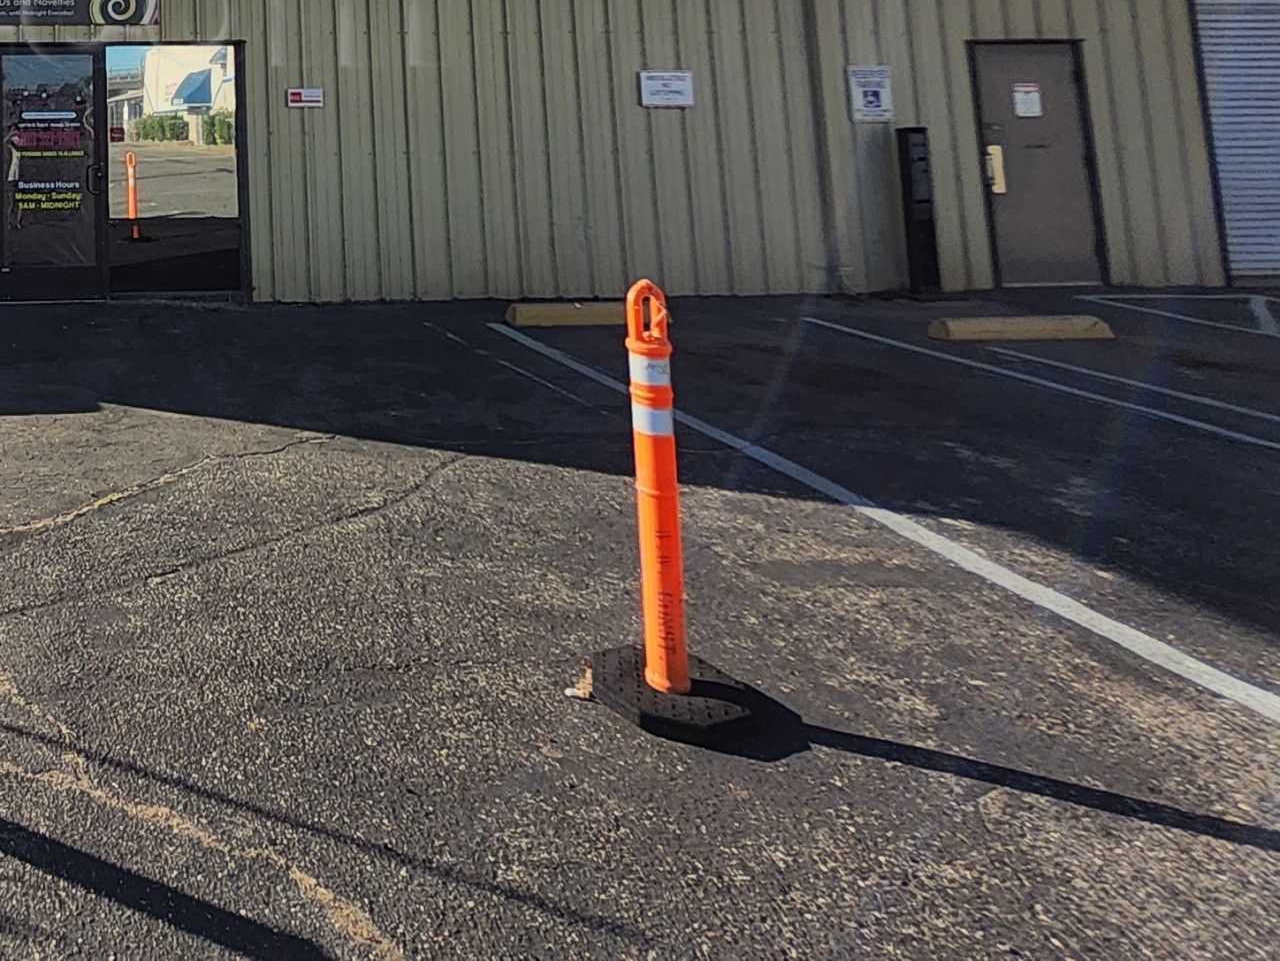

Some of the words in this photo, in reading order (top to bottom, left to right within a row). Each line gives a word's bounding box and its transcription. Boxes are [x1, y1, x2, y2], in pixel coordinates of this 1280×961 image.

[18, 181, 55, 190] Business
[56, 181, 80, 189] Hours
[15, 192, 46, 201] Monday
